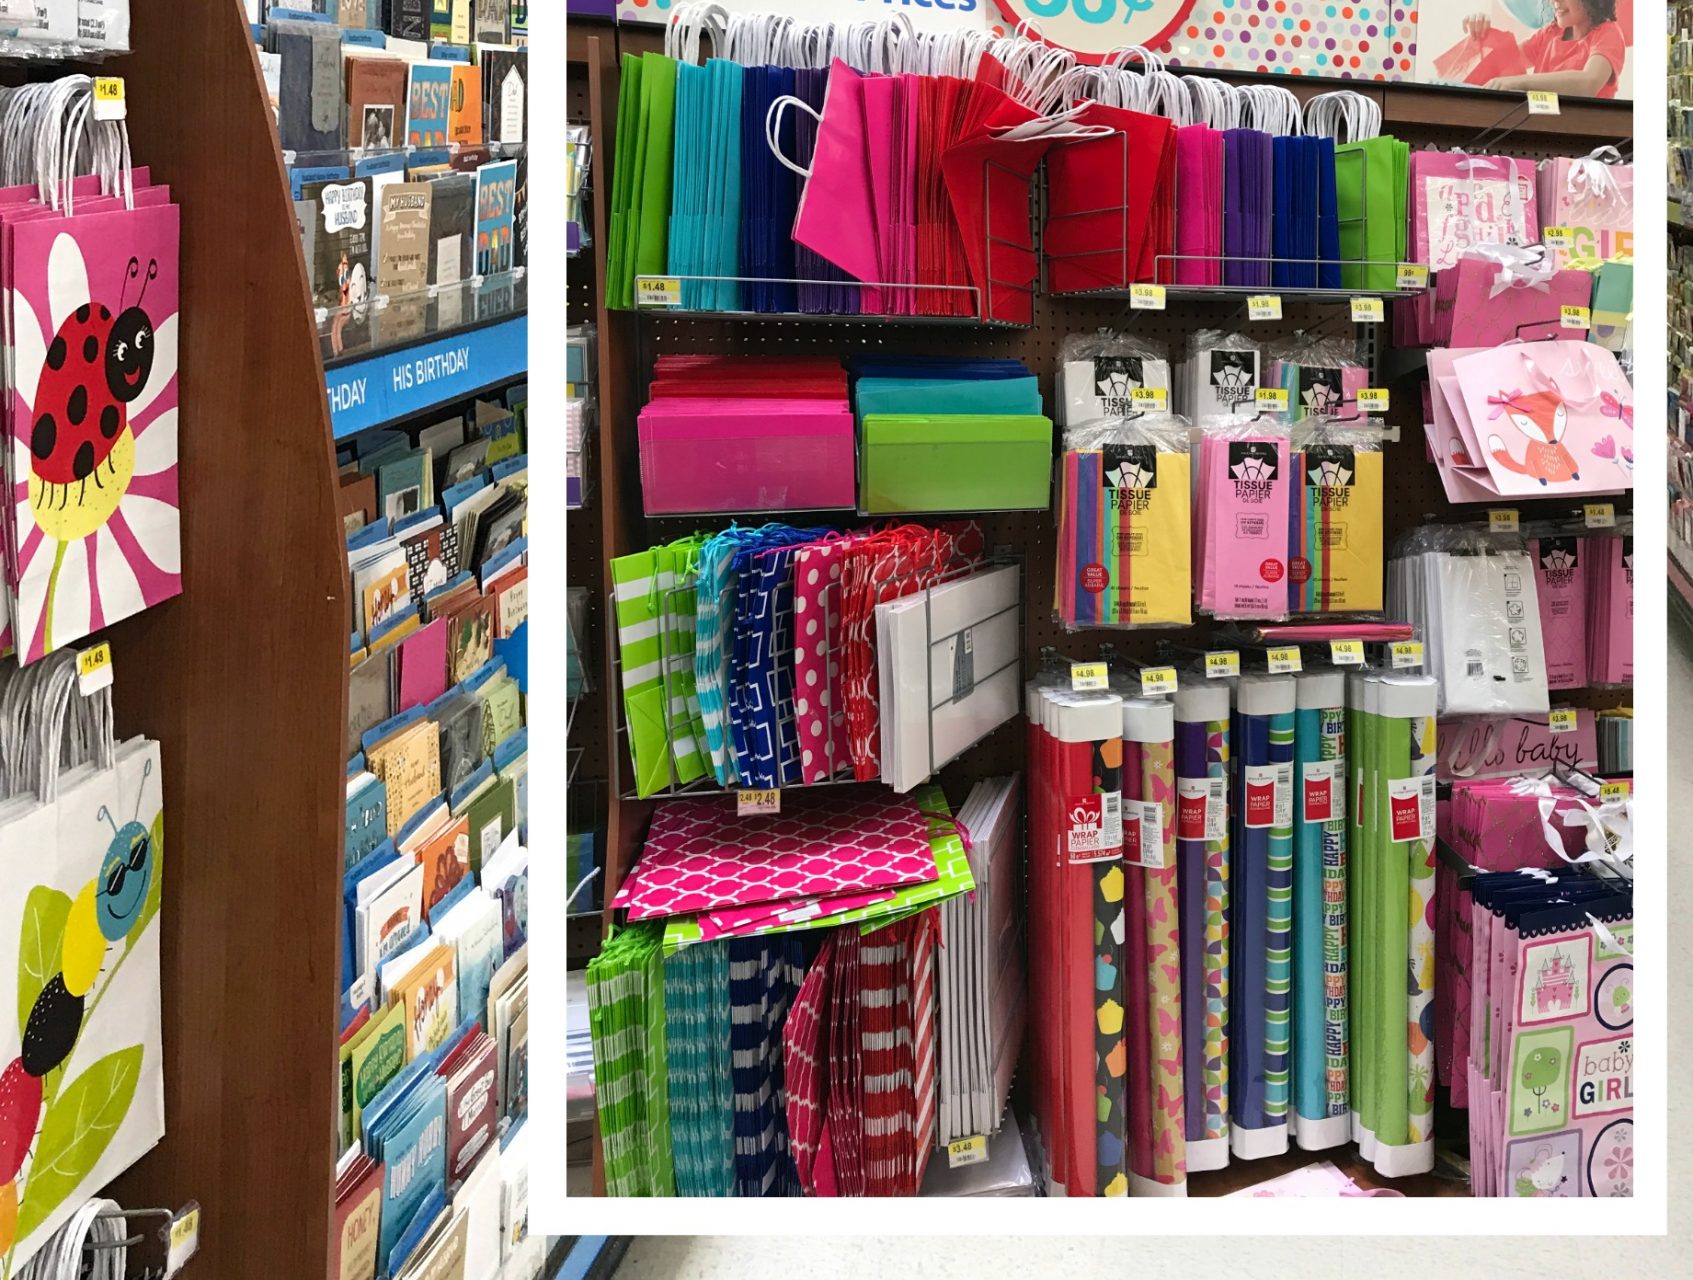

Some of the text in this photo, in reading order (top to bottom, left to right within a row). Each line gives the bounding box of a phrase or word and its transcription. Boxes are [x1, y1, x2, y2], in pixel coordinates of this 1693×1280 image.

[100, 83, 118, 96] $1.48
[411, 81, 449, 120] BEST
[479, 179, 513, 220] BEST
[642, 282, 665, 291] $1.48
[1135, 287, 1153, 297] $3.98
[393, 363, 413, 392] HIS
[416, 346, 470, 385] BIRTHDAY
[1135, 391, 1154, 399] $3.98
[1216, 386, 1250, 396] TISSUE
[1259, 392, 1277, 400] $1.98
[1360, 392, 1378, 400] $3.98
[1233, 480, 1273, 491] TISSUE
[1109, 489, 1151, 501] TISSUE
[1235, 490, 1271, 499] PAPIER
[1310, 487, 1350, 497] TISSUE
[1110, 500, 1150, 510] PAPIER
[1312, 496, 1349, 507] PAPIER
[1545, 568, 1575, 578] TISSUE
[1546, 577, 1573, 585] PAPIER
[1335, 644, 1352, 653] $4.98
[1396, 646, 1412, 655] $4.98
[85, 650, 104, 667] $1.48
[1210, 657, 1228, 665] $4.98
[1271, 652, 1289, 661] $4.98
[1076, 669, 1095, 678] $4.98
[1146, 673, 1164, 683] $4.98
[1515, 725, 1583, 766] baby
[755, 792, 776, 805] $2.48
[1071, 831, 1098, 839] WRAP
[1070, 838, 1100, 847] PAPIER
[1323, 831, 1338, 866] HAPPY
[1324, 927, 1339, 962] HAPPY
[1326, 1020, 1341, 1056] HAPPY
